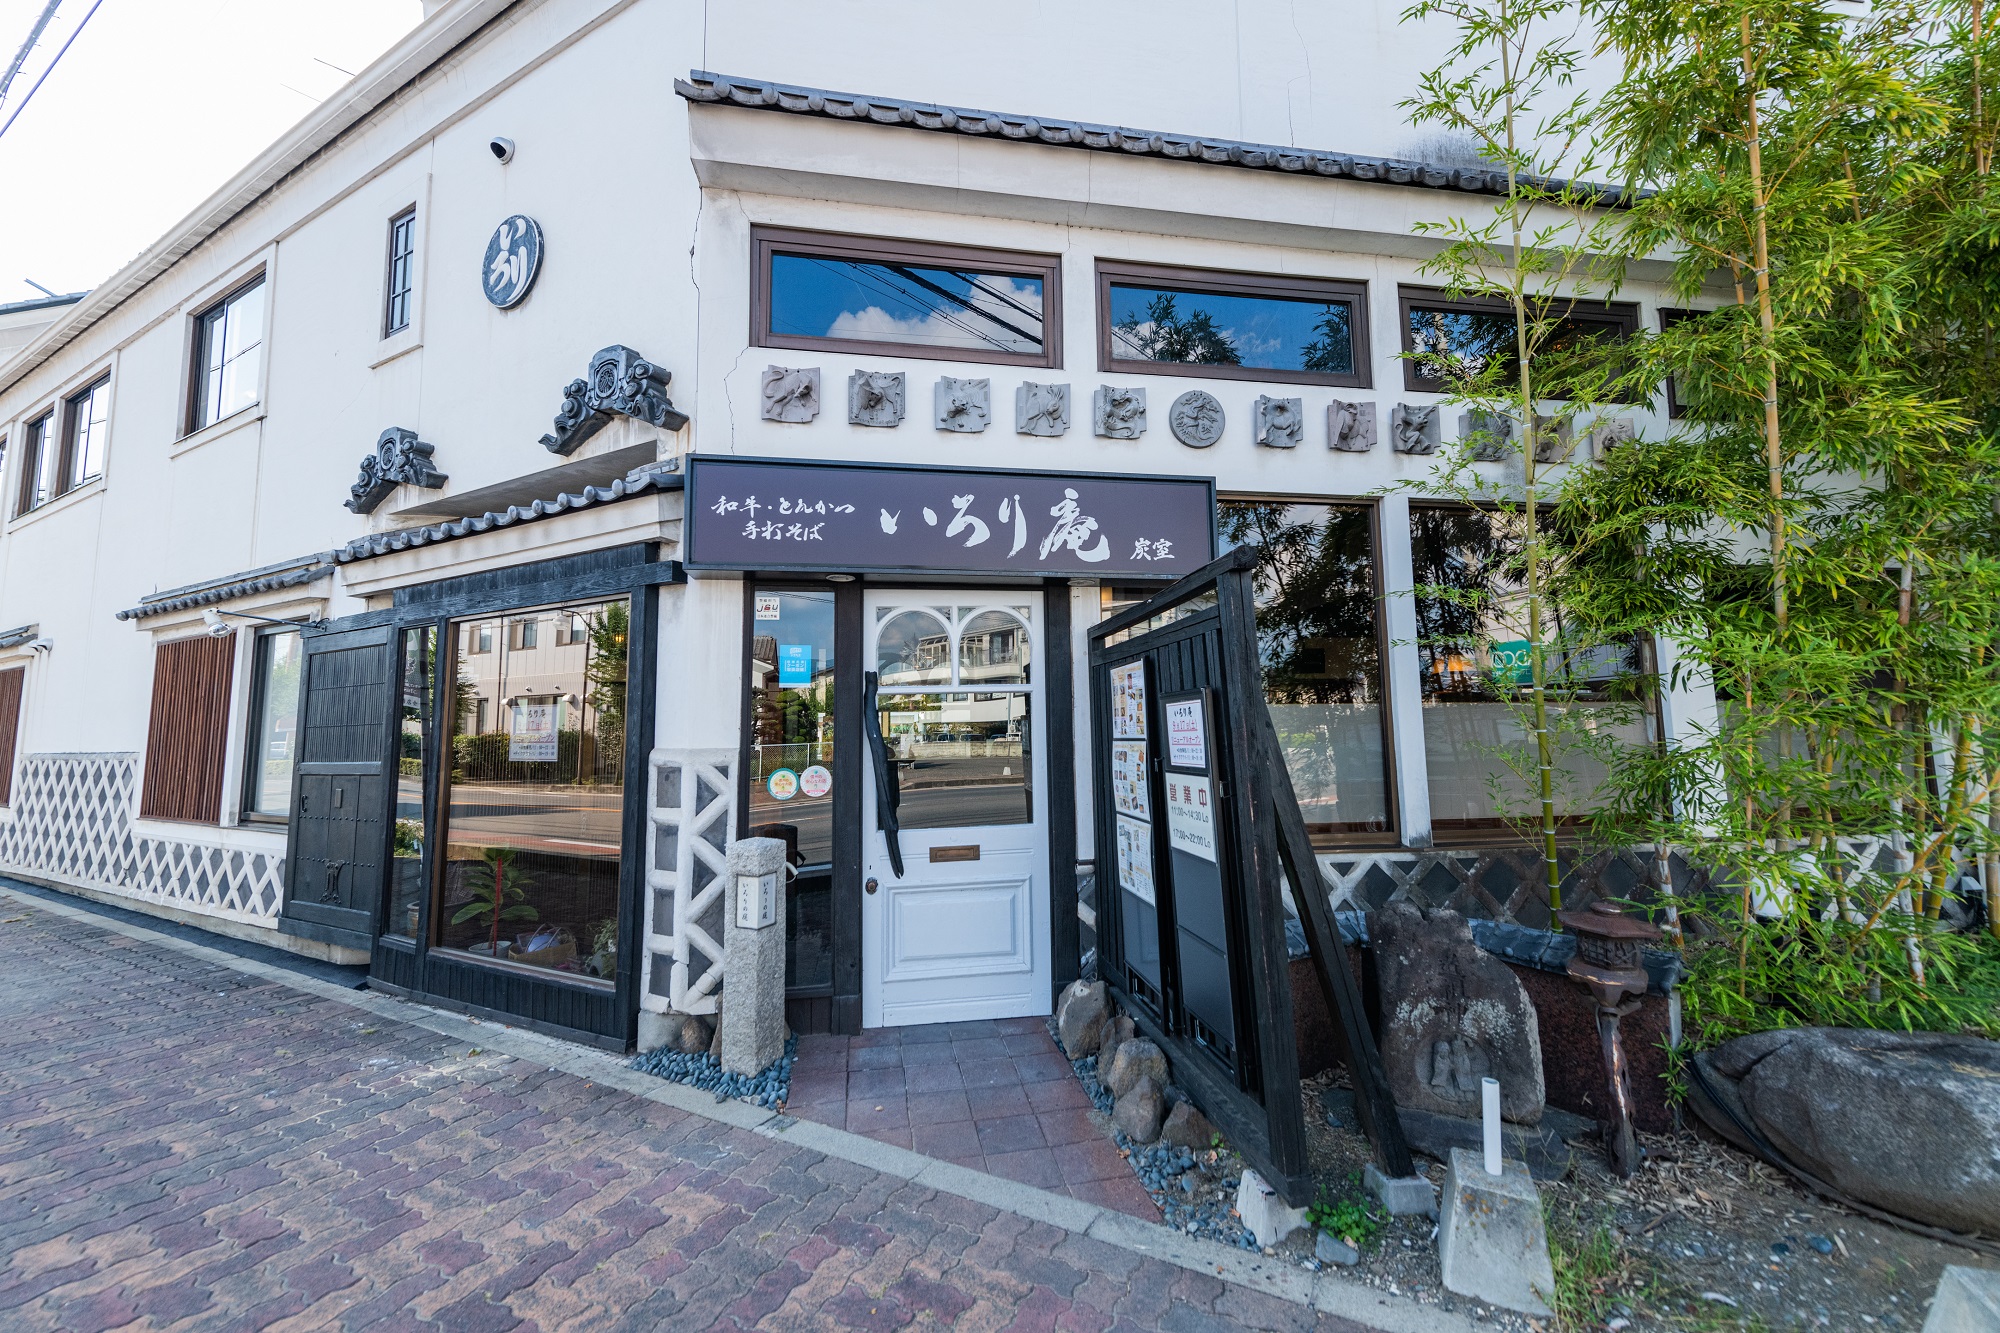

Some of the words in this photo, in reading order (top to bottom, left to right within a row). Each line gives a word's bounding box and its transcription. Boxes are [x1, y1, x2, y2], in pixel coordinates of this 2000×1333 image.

[742, 520, 826, 541] 手打そば
[879, 487, 1111, 563] いろり庵
[1169, 783, 1208, 808] 営業中
